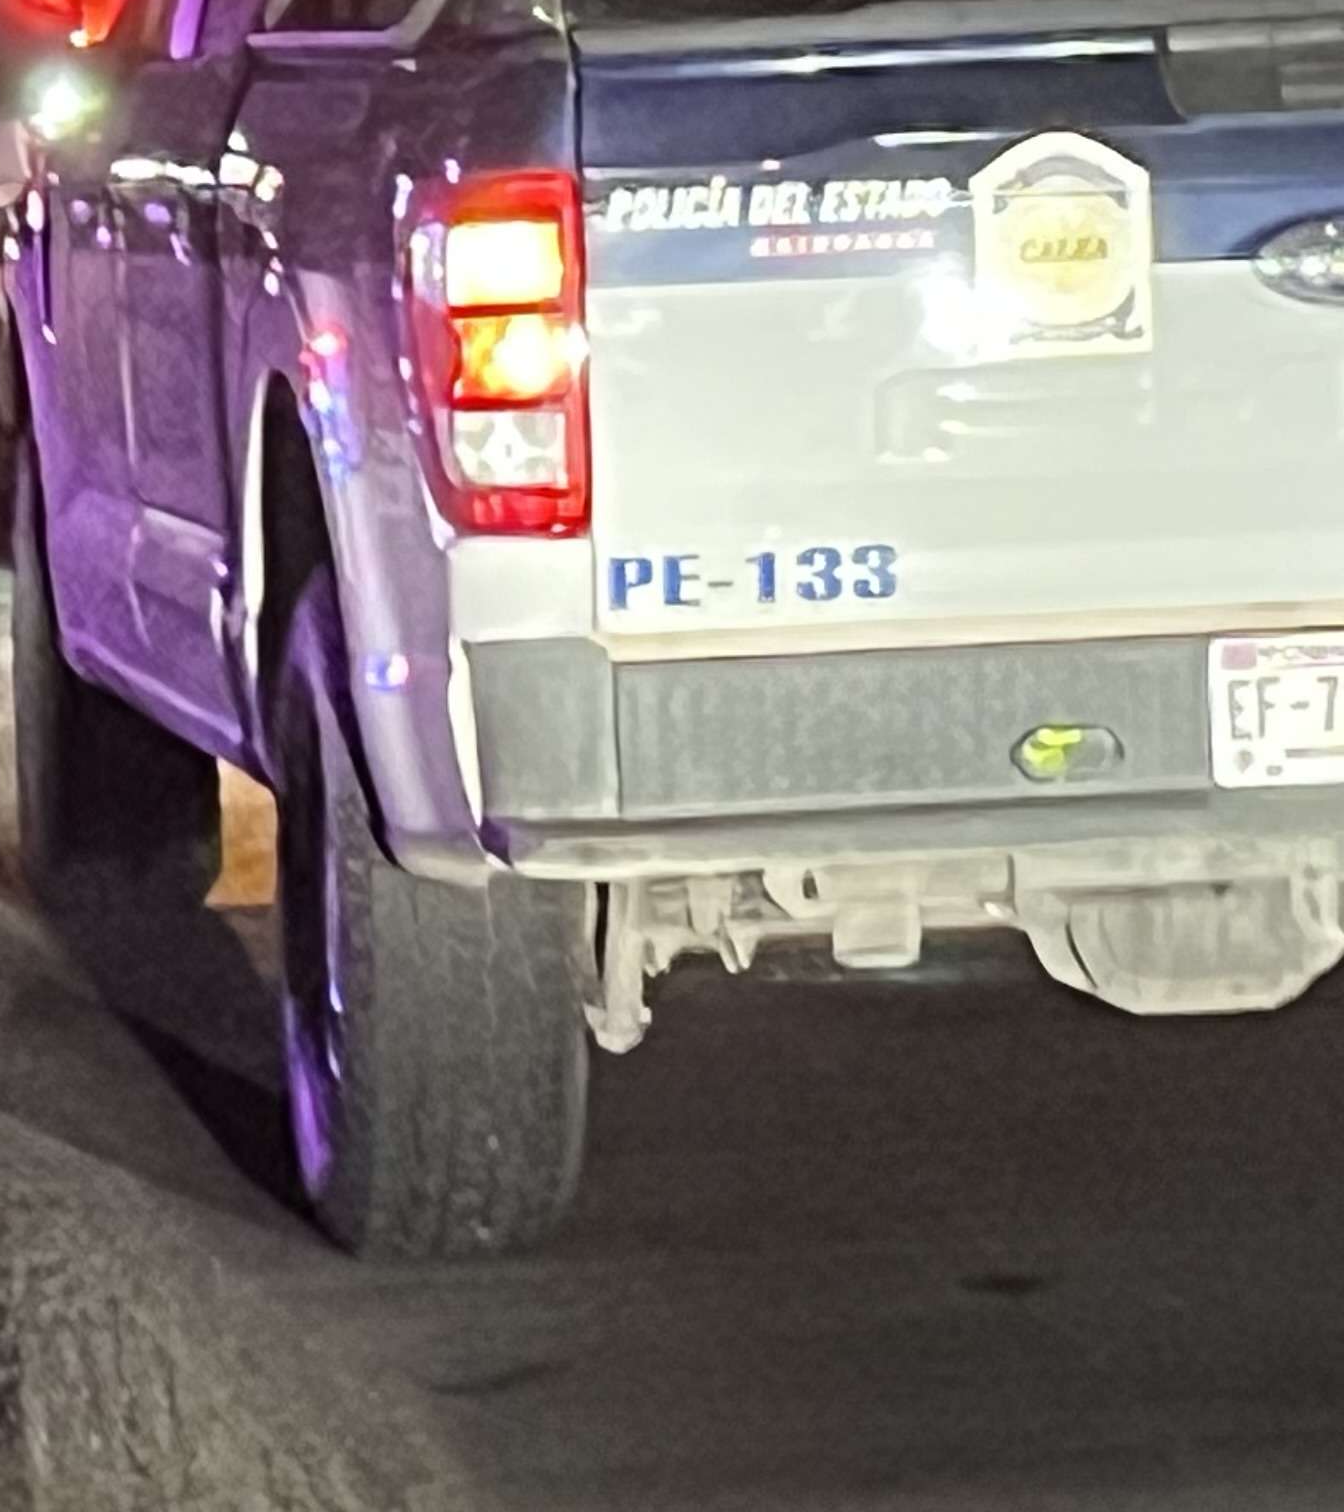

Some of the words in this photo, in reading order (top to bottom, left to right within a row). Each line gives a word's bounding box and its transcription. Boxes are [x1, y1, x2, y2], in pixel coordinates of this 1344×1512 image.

[749, 181, 810, 226] DEL
[819, 177, 953, 223] ESTADO
[608, 544, 898, 611] PE-133
